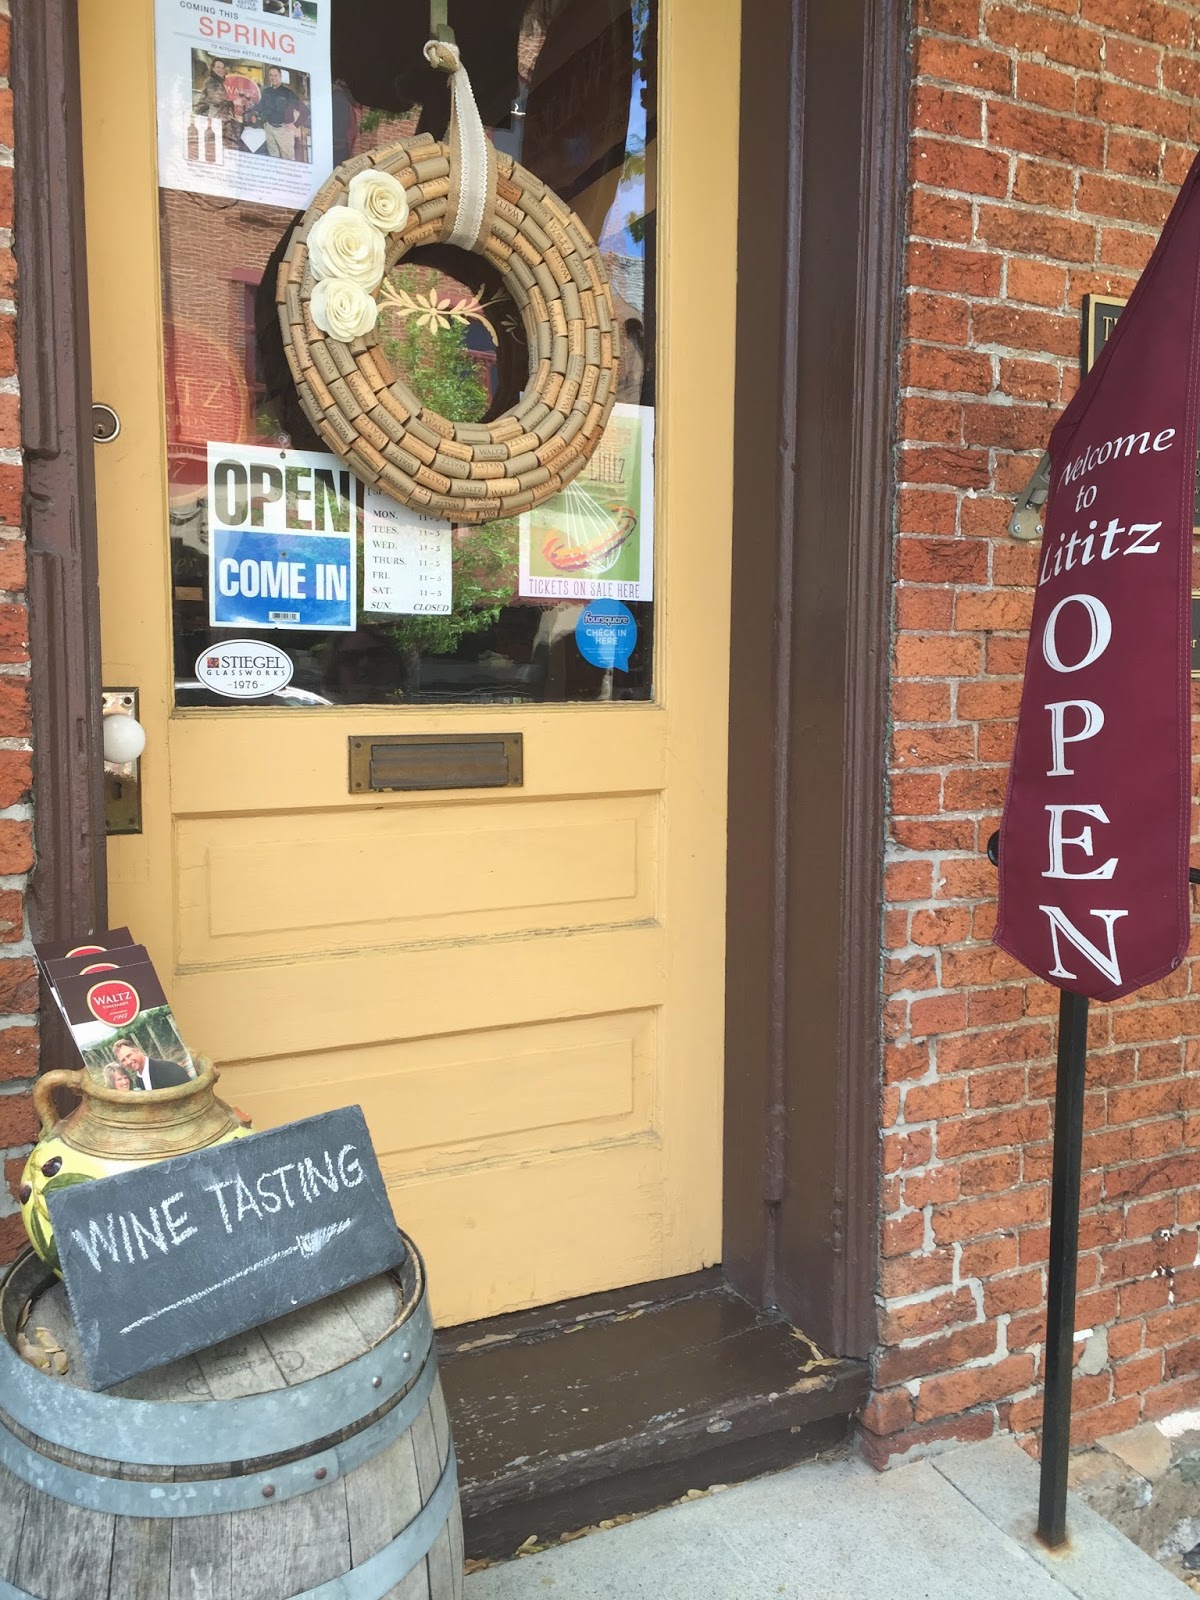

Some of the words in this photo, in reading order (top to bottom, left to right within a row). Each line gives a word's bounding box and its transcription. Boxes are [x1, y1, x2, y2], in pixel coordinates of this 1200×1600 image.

[179, 0, 216, 15] COMING
[219, 9, 239, 20] THIS
[199, 16, 296, 55] SPRING
[219, 45, 241, 54] KITCHEN
[242, 50, 261, 58] KETTLE
[262, 54, 282, 62] VILLAGE
[581, 368, 596, 398] WALTZ
[336, 384, 356, 414] WALTZ
[560, 381, 578, 410] WALTZ
[329, 412, 350, 439] WALTZ
[377, 410, 400, 436] WALTZ
[510, 431, 537, 448] WALTZ
[389, 450, 414, 471] WALTZ
[479, 448, 505, 456] WALTZ
[1056, 428, 1176, 494] Welcome
[421, 469, 448, 490] WALTZ
[457, 485, 483, 494] WALTZ
[214, 458, 351, 533] OPEN
[1075, 485, 1098, 513] to
[373, 510, 398, 519] MON.
[372, 525, 399, 534] TUES.
[372, 541, 398, 550] WED.
[1038, 517, 1163, 588] Lititz
[372, 556, 407, 565] THURS.
[219, 557, 307, 601] COME
[315, 563, 348, 602] IN
[372, 571, 391, 580] FRI.
[372, 587, 392, 595] SAT.
[529, 579, 569, 595] TICKETS
[573, 581, 586, 596] ON
[590, 582, 613, 598] SALE
[617, 583, 640, 599] HERE
[371, 602, 392, 610] SUN.
[413, 603, 450, 612] CLOSED
[584, 611, 628, 627] foursquare
[586, 628, 616, 637] CHECK
[617, 629, 627, 637] IN
[595, 637, 618, 645] HERE
[221, 655, 286, 669] STIEGEL
[1038, 593, 1129, 986] OPEN
[93, 991, 132, 1006] WALTZ
[70, 1191, 199, 1273] WINE
[205, 1143, 366, 1234] TASTING
